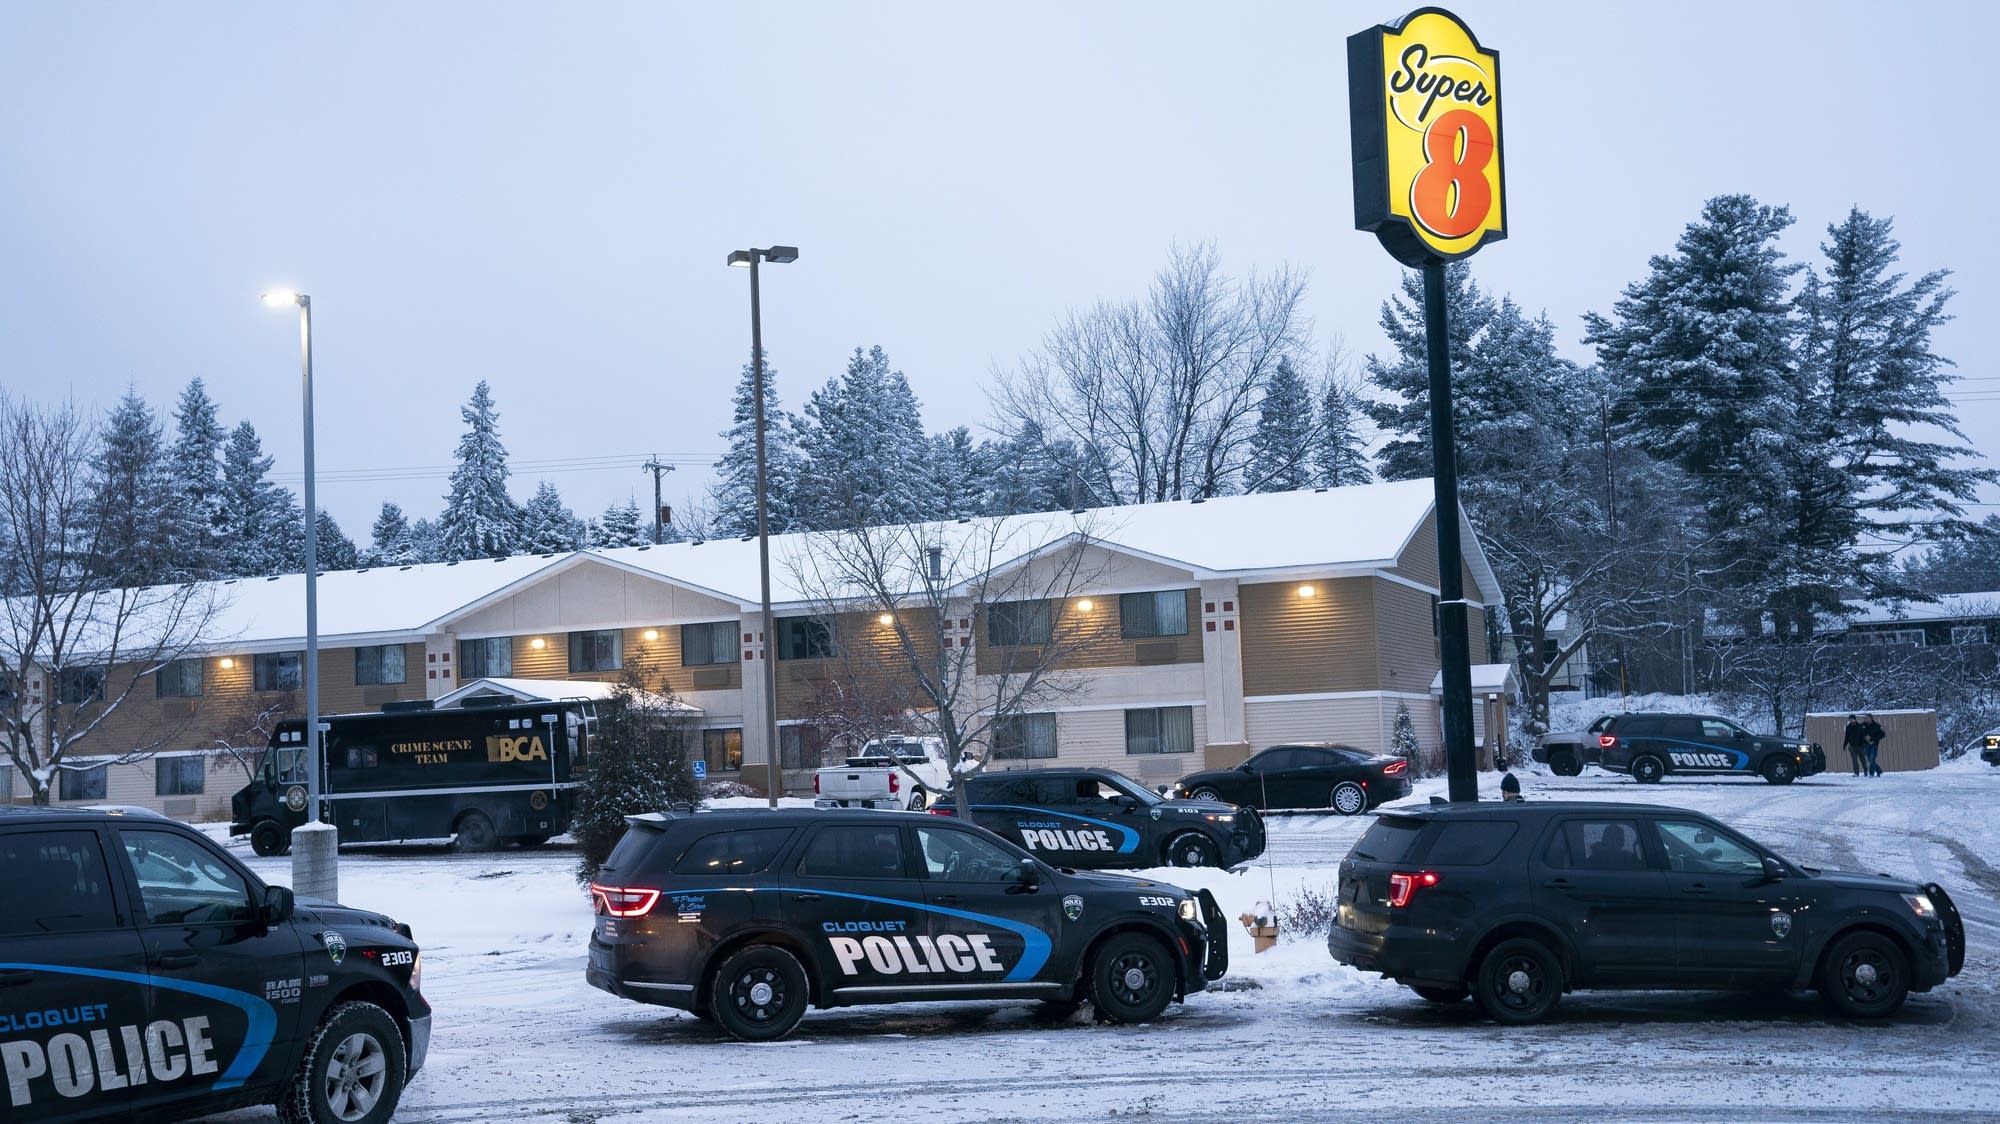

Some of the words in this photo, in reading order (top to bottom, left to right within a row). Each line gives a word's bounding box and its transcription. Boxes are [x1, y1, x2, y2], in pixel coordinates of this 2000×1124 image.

[1390, 43, 1493, 123] Super
[1409, 108, 1494, 240] 8
[391, 742, 431, 754] CRIME
[432, 739, 472, 751] SCENE
[500, 735, 548, 762] BCA
[415, 753, 448, 764] TEAM
[1669, 752, 1732, 767] POLICE
[1017, 821, 1062, 829] CLOQUET
[1020, 829, 1114, 851] POLICE
[1139, 896, 1176, 907] 2302
[822, 920, 906, 932] CLOQUET
[381, 950, 413, 967] 2303
[829, 934, 1004, 976] POLICE
[265, 978, 301, 990] RAM
[265, 987, 301, 1000] 1500
[0, 1003, 108, 1033] CLOQUET
[0, 1015, 219, 1107] POLICE
